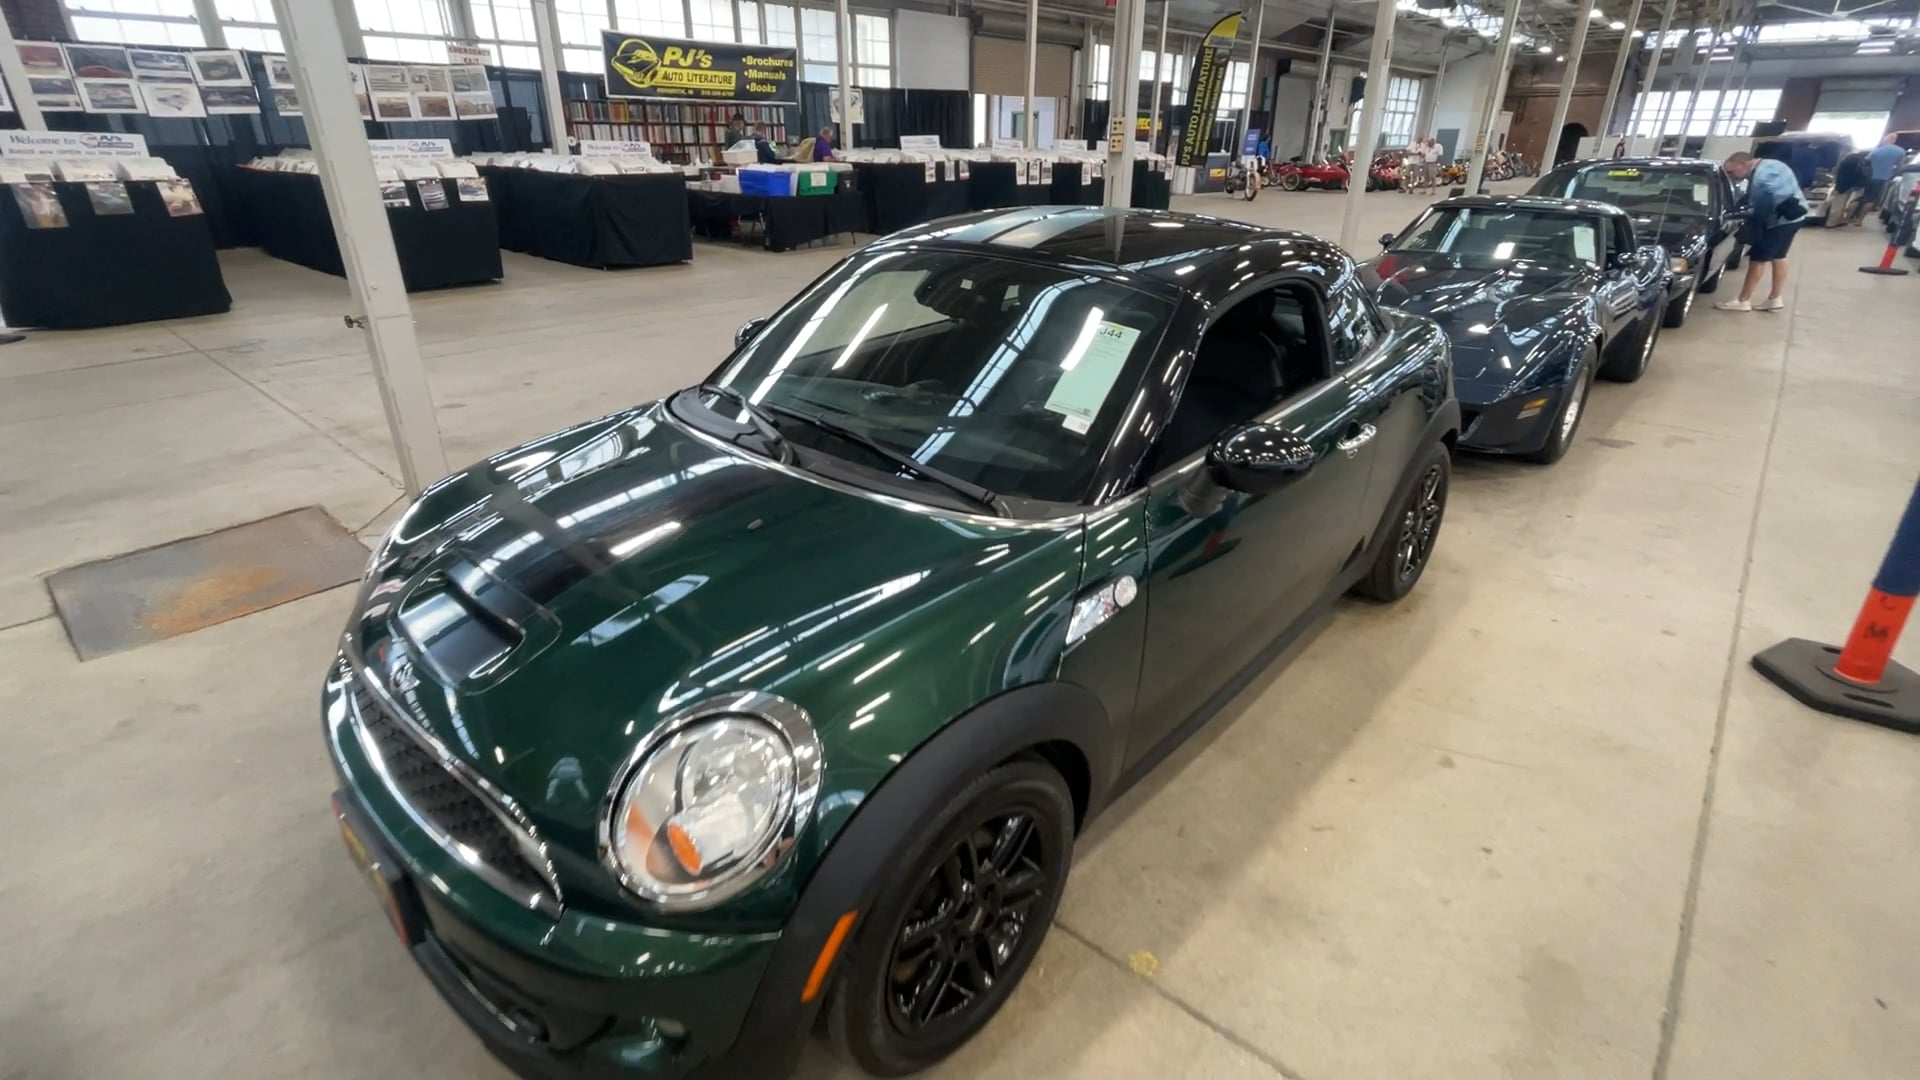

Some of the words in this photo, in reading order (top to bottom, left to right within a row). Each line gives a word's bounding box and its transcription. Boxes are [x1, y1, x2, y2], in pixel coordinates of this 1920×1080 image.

[663, 46, 713, 68] PJ's
[746, 55, 794, 67] Brochures
[661, 70, 684, 82] AUTO
[687, 71, 733, 84] LITERATURE
[748, 69, 786, 80] Manuals
[1192, 47, 1214, 115] LITERATURE
[750, 82, 777, 93] Books
[1186, 115, 1199, 144] AUTO
[9, 135, 60, 145] Welcome
[63, 137, 76, 145] to
[1181, 145, 1193, 165] PJ'S
